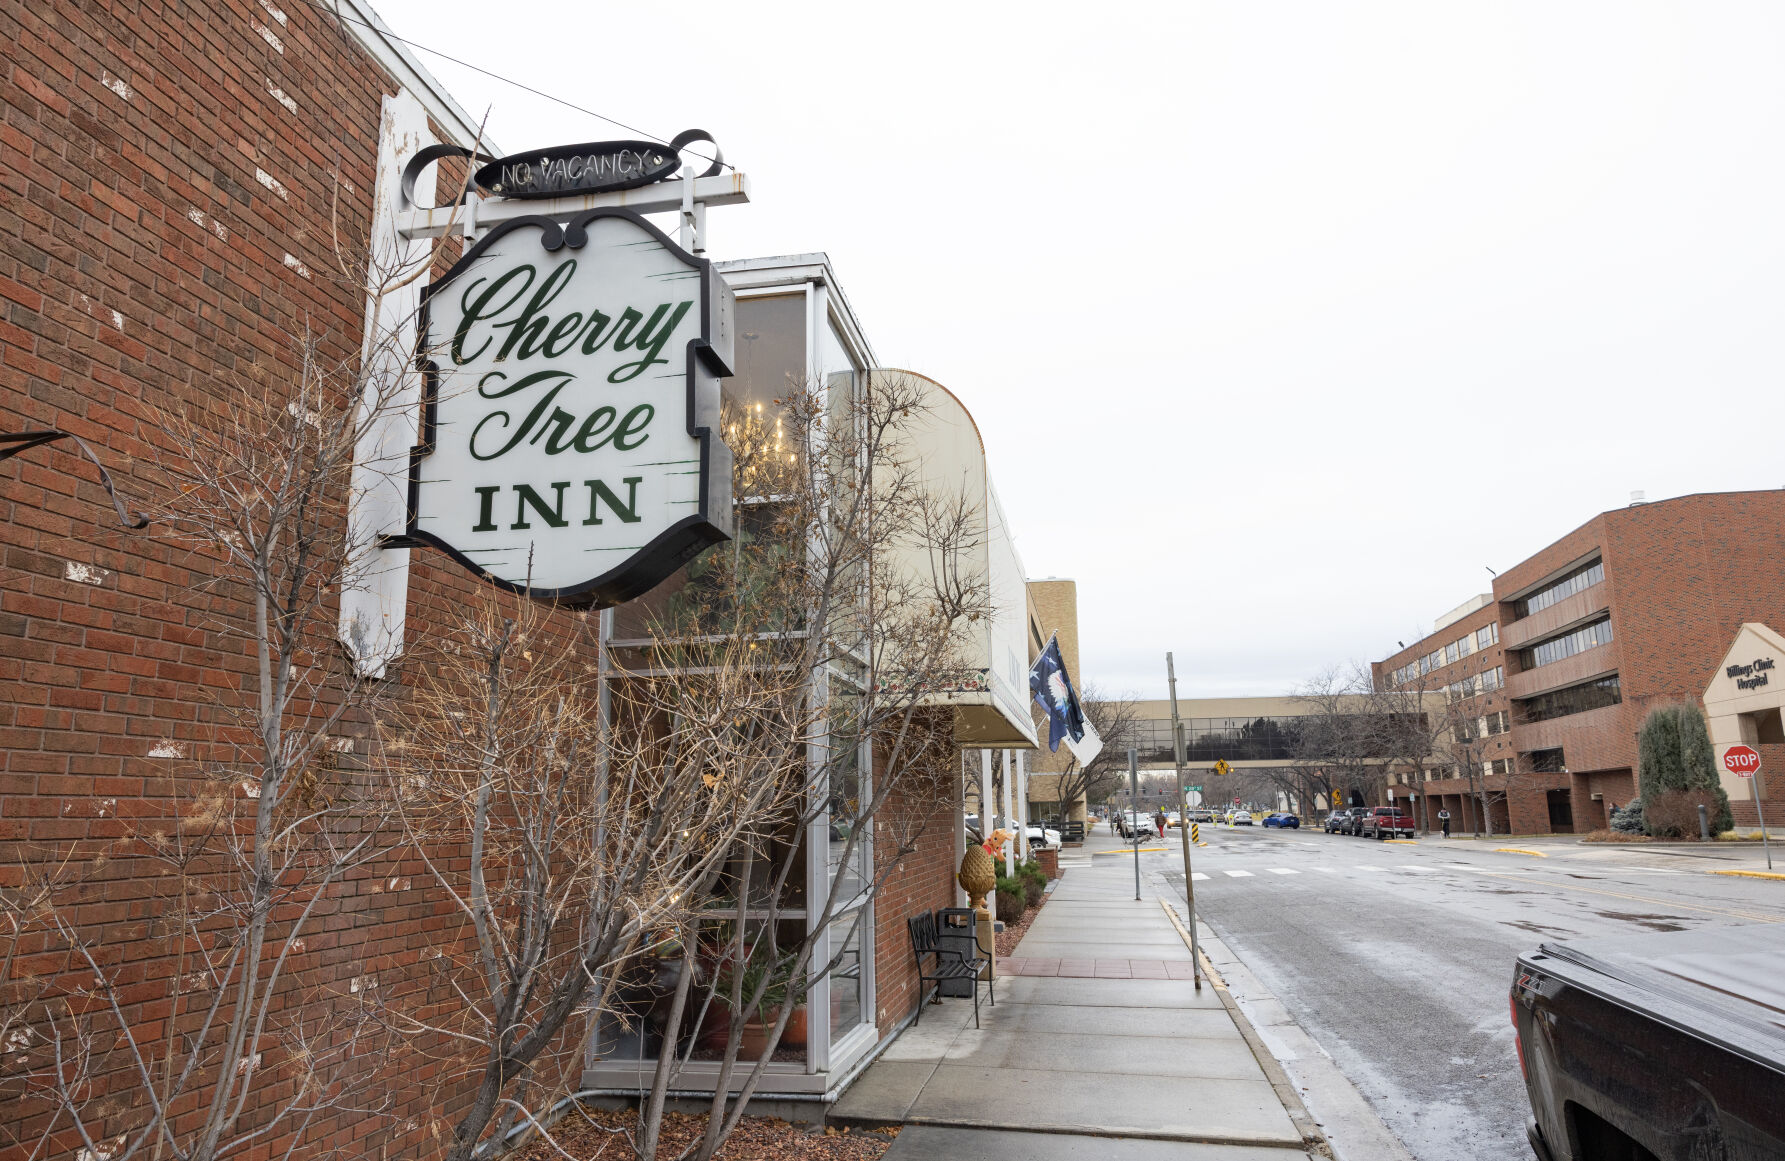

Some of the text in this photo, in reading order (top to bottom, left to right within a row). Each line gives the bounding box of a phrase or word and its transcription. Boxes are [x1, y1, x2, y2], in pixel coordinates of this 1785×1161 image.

[501, 149, 651, 187] NO VACANCY
[450, 258, 694, 384] Cherry
[469, 370, 656, 462] Tree
[472, 476, 643, 532] INN
[1726, 657, 1775, 679] Billings Clinic
[1736, 672, 1768, 691] Hospital
[1726, 753, 1757, 768] STOP
[1516, 973, 1546, 994] Z71
